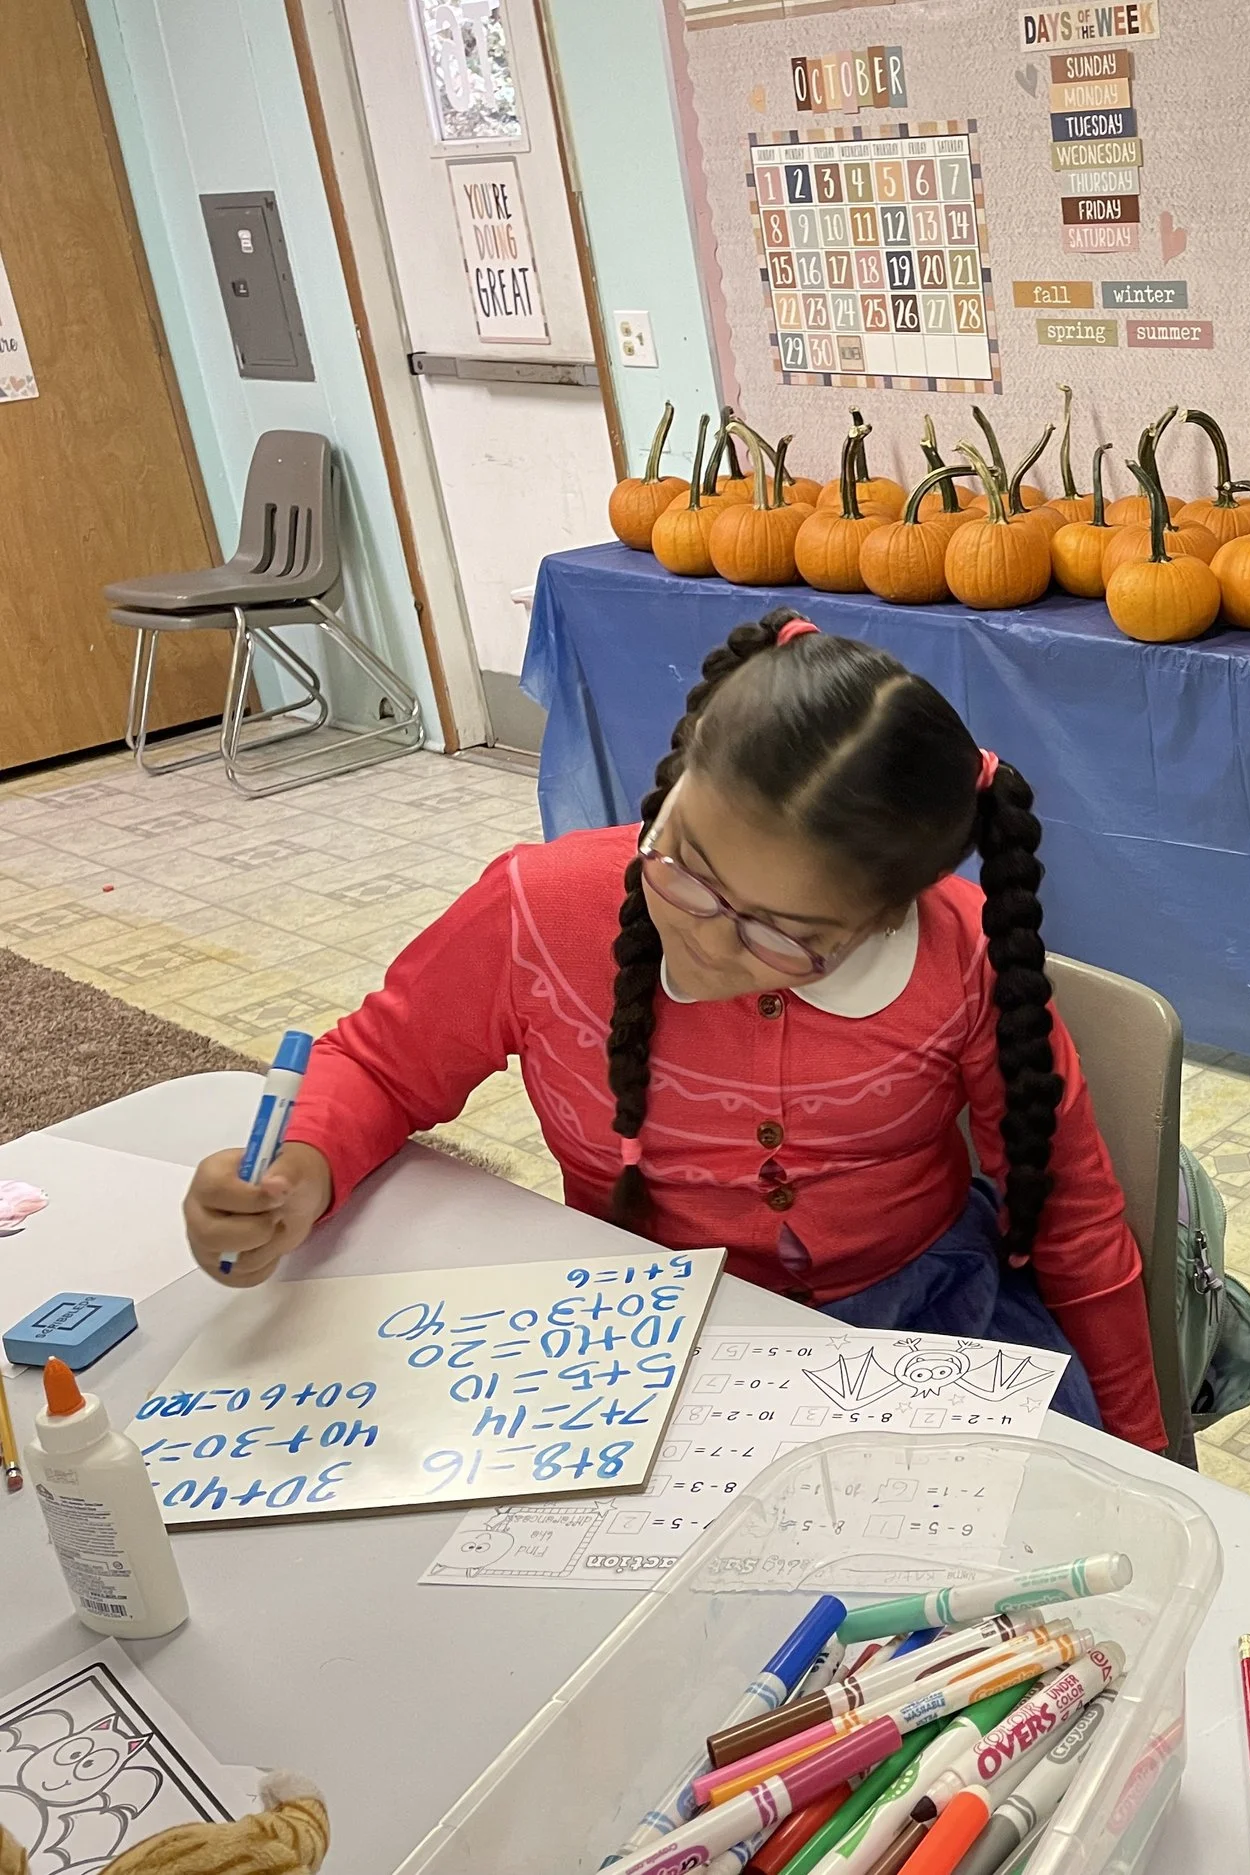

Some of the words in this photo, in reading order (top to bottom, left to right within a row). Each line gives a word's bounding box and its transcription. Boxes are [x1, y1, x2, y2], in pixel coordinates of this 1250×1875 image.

[1078, 10, 1090, 23] OF
[1095, 3, 1155, 38] WEEK
[1025, 12, 1072, 44] DAYS
[1076, 25, 1095, 39] THE
[1066, 53, 1116, 79] SUNDAY
[794, 56, 903, 105] OCTOBER
[1065, 84, 1118, 107] MONDAY
[1065, 113, 1123, 138] TUESDAY
[1056, 141, 1136, 166] WEDNESDAY
[764, 171, 775, 200] 1
[793, 169, 805, 198] 2
[821, 168, 834, 198] 3
[852, 167, 864, 197] 4
[883, 167, 896, 197] 5
[916, 166, 929, 195] 6
[948, 164, 959, 194] 7
[1068, 173, 1132, 193] THURSDAY
[463, 183, 512, 220] YOU'RE
[1079, 199, 1121, 221] FRIDAY
[771, 215, 783, 243] 8
[800, 214, 808, 243] 9
[824, 214, 844, 242] 10
[854, 212, 875, 241] 11
[884, 211, 907, 241] 12
[915, 210, 938, 241] 13
[949, 211, 970, 239] 14
[474, 224, 518, 260] DOING
[1068, 226, 1131, 248] SATURDAY
[772, 256, 793, 284] 15
[799, 257, 821, 285] 16
[828, 257, 848, 284] 17
[859, 256, 879, 284] 18
[889, 256, 910, 286] 19
[922, 255, 944, 285] 20
[953, 255, 977, 285] 21
[476, 267, 534, 317] GREAT
[1033, 286, 1071, 304] fall
[1113, 285, 1175, 304] winter
[778, 298, 797, 327] 22
[807, 298, 827, 327] 23
[835, 299, 855, 327] 24
[864, 299, 887, 328] 25
[895, 299, 917, 329] 26
[926, 299, 945, 328] 27
[958, 299, 981, 329] 28
[1047, 323, 1106, 343] spring
[1136, 325, 1202, 341] summer
[785, 337, 802, 365] 29
[811, 337, 832, 366] 30
[768, 1347, 779, 1356] 5
[797, 1346, 813, 1357] 10
[750, 1379, 761, 1389] 0
[779, 1379, 791, 1389] 7
[727, 1410, 741, 1421] 2
[758, 1410, 775, 1420] 10
[849, 1412, 859, 1423] 5
[881, 1412, 893, 1423] 8
[967, 1414, 980, 1424] 2
[1001, 1415, 1012, 1425] 4
[710, 1446, 722, 1457] 7
[742, 1446, 755, 1457] 7
[691, 1482, 705, 1493] 3
[724, 1481, 737, 1493] 8
[973, 1487, 985, 1498] 7
[670, 1518, 681, 1529] 5
[928, 1522, 939, 1534] 5
[961, 1524, 973, 1536] 6
[1048, 1674, 1080, 1700] UNDER
[1055, 1684, 1084, 1710] COLOR
[973, 1701, 1043, 1755] COLOR
[1051, 1709, 1098, 1759] Crayola
[977, 1703, 1057, 1780] OVERS
